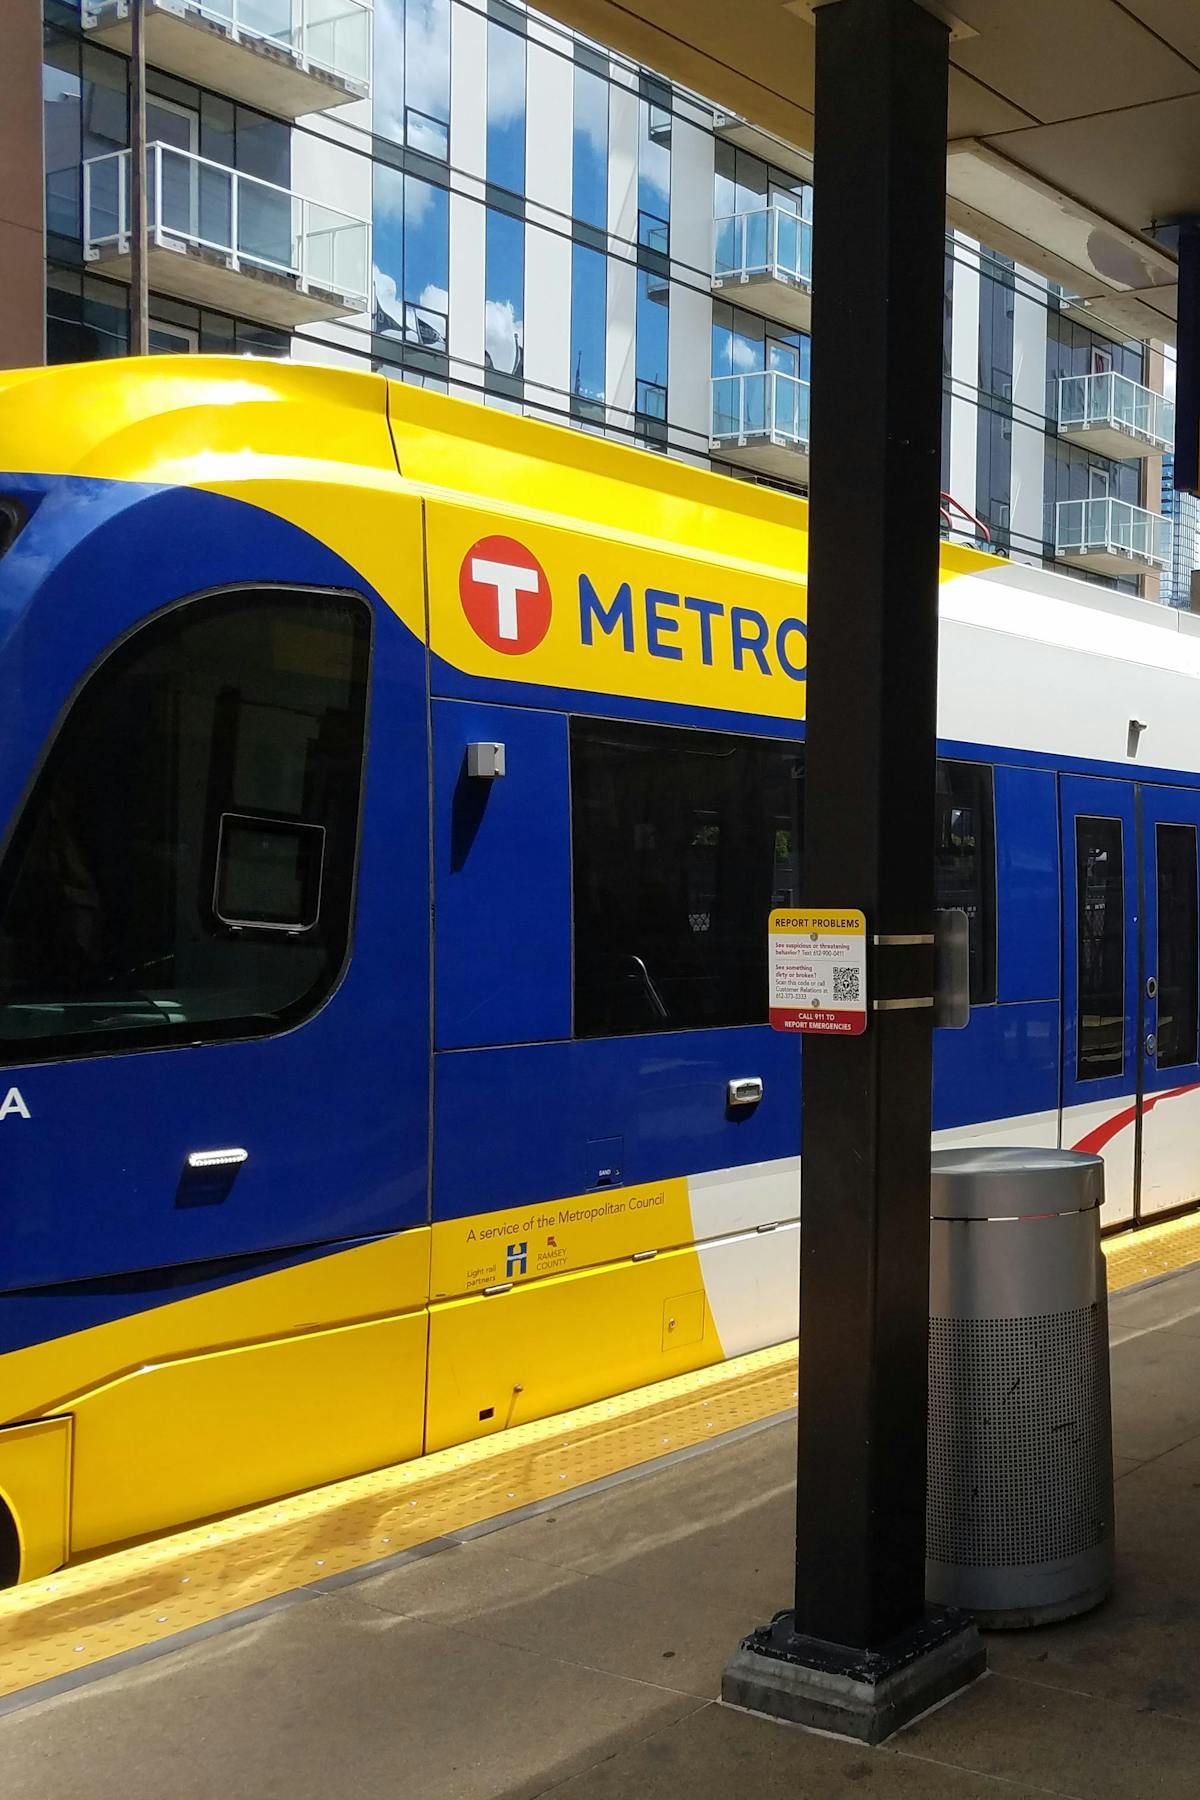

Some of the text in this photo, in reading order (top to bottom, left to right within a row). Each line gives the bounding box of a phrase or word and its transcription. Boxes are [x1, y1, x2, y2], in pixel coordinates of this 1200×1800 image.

[471, 558, 808, 681] T METRO
[775, 919, 859, 928] REPORT PROBLEMS
[784, 1021, 851, 1030] REPORT EMERGENCIES
[465, 1192, 664, 1242] A service of the Metropolitan Council
[537, 1248, 567, 1261] RAMSEY
[466, 1264, 497, 1278] Light rail
[536, 1257, 568, 1271] COUNTY
[466, 1274, 496, 1288] partners
